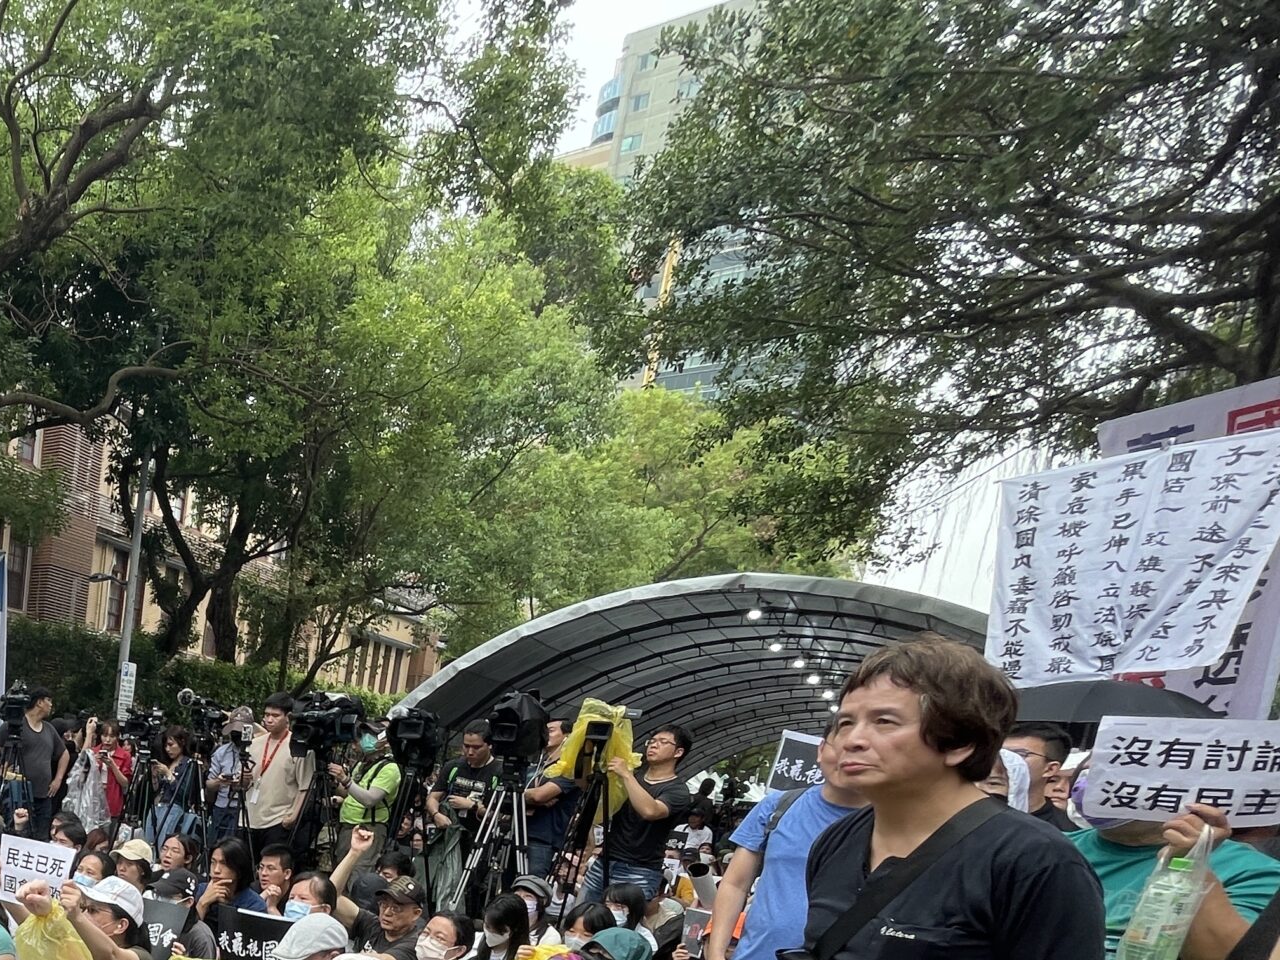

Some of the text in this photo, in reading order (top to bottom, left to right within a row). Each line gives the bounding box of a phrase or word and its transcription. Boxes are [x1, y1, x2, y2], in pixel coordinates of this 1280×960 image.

[1108, 736, 1280, 773] 沒有討論
[6, 847, 67, 878] 民主已死
